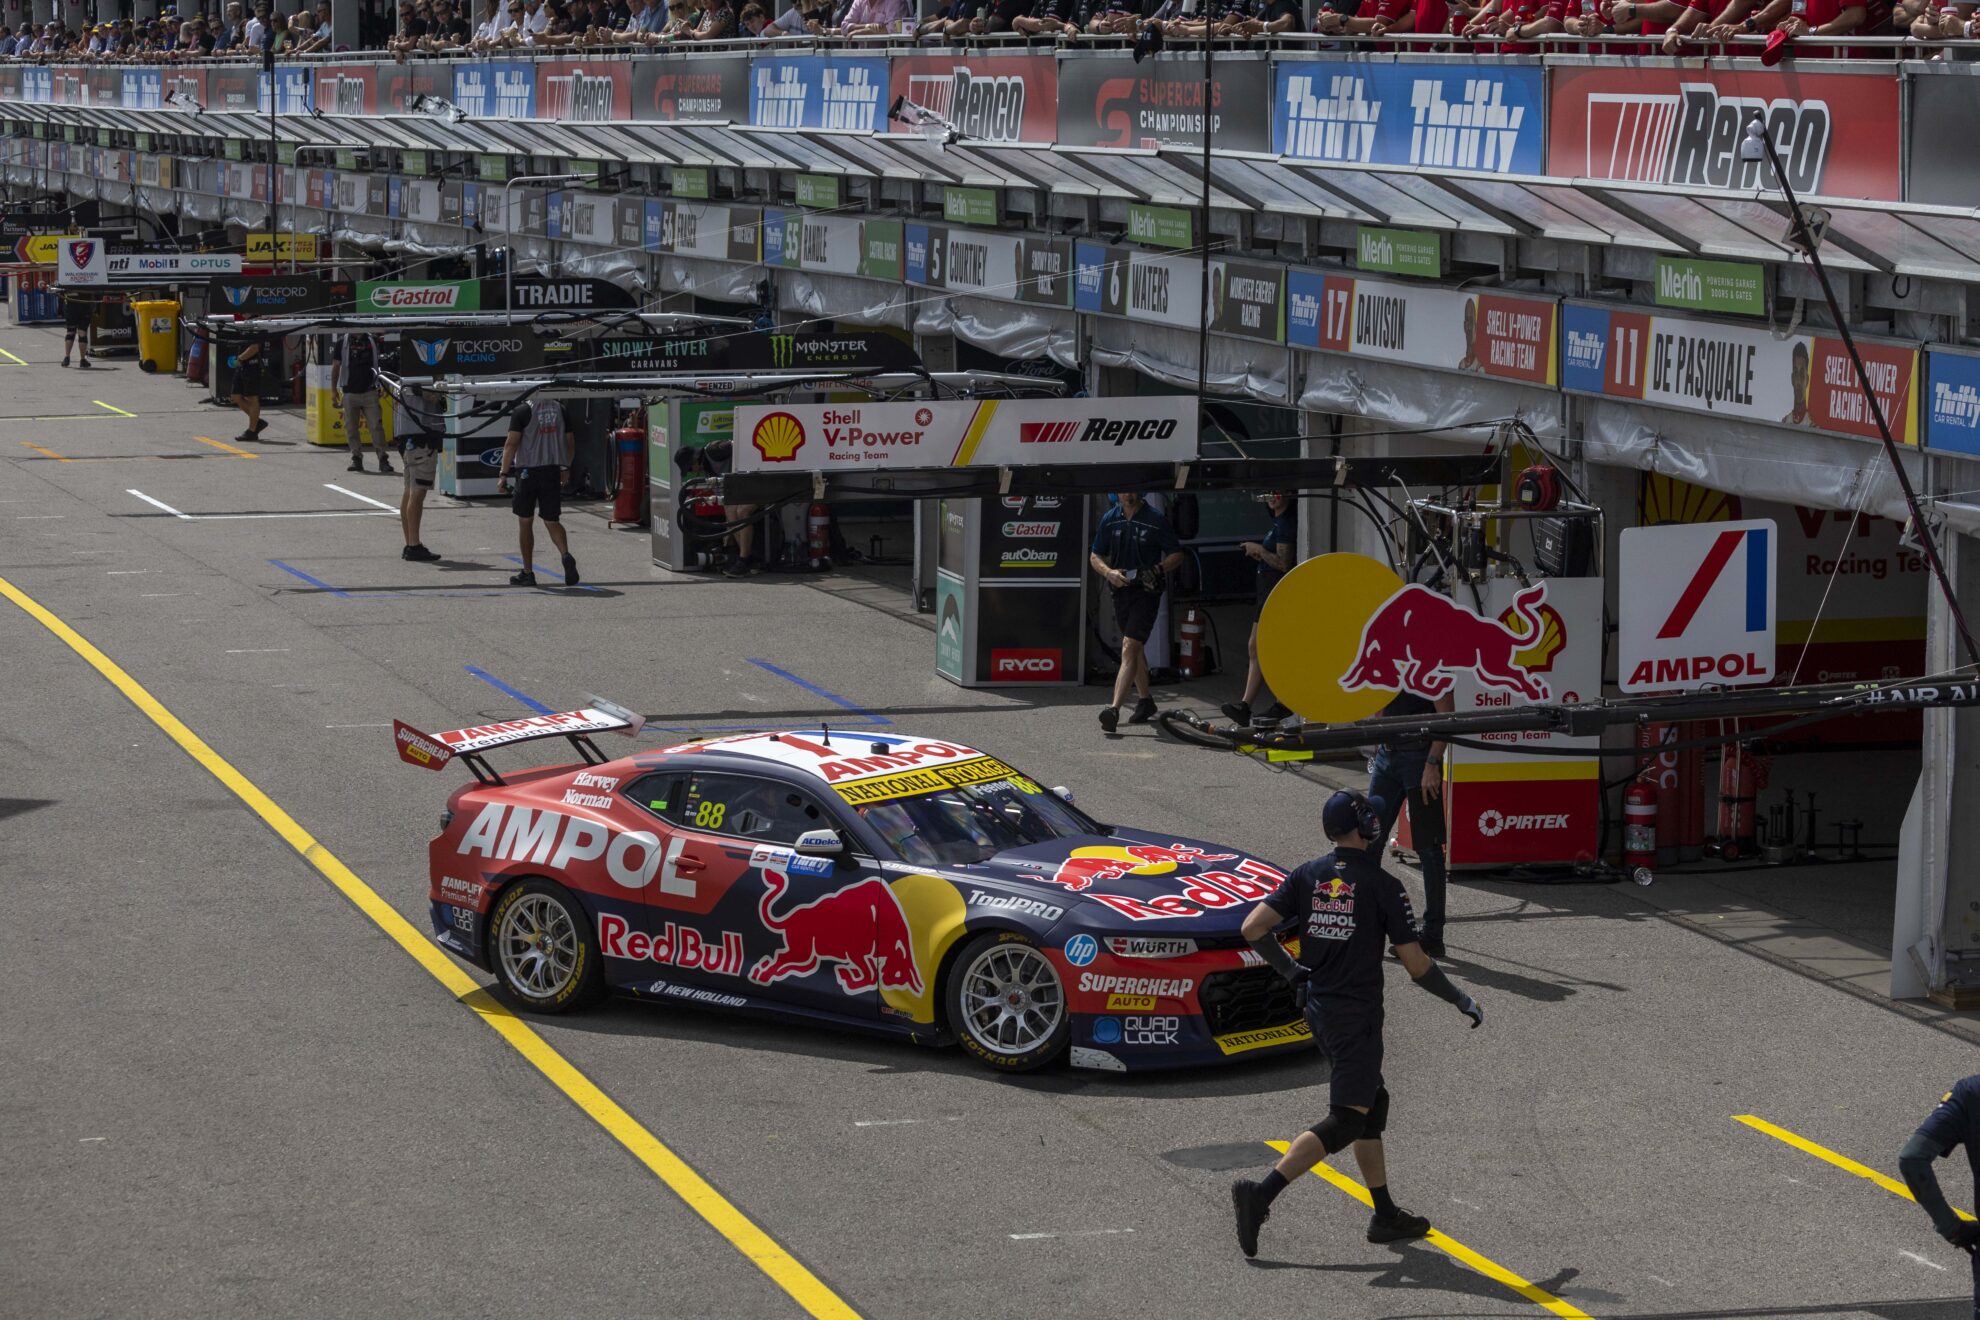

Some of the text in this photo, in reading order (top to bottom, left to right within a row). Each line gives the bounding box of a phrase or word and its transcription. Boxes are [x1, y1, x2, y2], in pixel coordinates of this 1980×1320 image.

[572, 69, 613, 121] Repco
[678, 98, 721, 113] CHAMPIONSHIP
[756, 66, 808, 127] Thrifty
[822, 67, 880, 130] Thrifty
[953, 66, 1025, 141] Repco
[1285, 76, 1382, 163] Thrifty
[1409, 79, 1525, 174] Thrifty
[1667, 83, 1831, 196] Repco
[946, 191, 967, 217] Merlin
[662, 211, 673, 246] 56
[1130, 209, 1156, 238] Merlin
[249, 241, 287, 253] JAX
[785, 222, 799, 260] 55
[803, 224, 828, 263] RANDLE
[1361, 233, 1392, 265] Merlin
[139, 258, 168, 269] Mobil
[190, 258, 231, 269] OPTUS
[931, 238, 941, 280] 5
[949, 241, 988, 287] COURTNEY
[253, 286, 308, 298] TICKFORD
[515, 284, 593, 306] TRADIE
[1110, 260, 1120, 306] 6
[1131, 263, 1170, 315] WATERS
[1229, 276, 1276, 305] MONSTER ENERGY
[1660, 264, 1702, 301] Merlin
[1706, 276, 1756, 289] POWERING GARAGE
[1710, 289, 1728, 299] DOORS
[1735, 291, 1752, 301] GATES
[256, 297, 287, 305] RACING
[393, 286, 453, 306] Castrol
[1240, 303, 1261, 328] RACING
[1291, 293, 1320, 327] Thrifty
[1327, 289, 1348, 341] 17
[1356, 293, 1406, 350] DAVISON
[111, 326, 131, 336] paoli
[1486, 309, 1542, 343] SHELL V-POWER
[453, 339, 523, 353] TICKFORD
[457, 353, 496, 363] RACING
[602, 339, 708, 358] SNOWY RIVER
[796, 339, 868, 353] MONSTER
[1490, 340, 1536, 371] RACING TEAM
[1567, 329, 1605, 370] Thrifty
[1614, 326, 1639, 387] 11
[631, 359, 678, 369] CARAVANS
[1652, 333, 1756, 410] DE PASQUALE
[1824, 354, 1898, 395] SHELL VPOWER
[708, 381, 733, 391] ENZED
[823, 409, 861, 425] Shell
[1829, 389, 1862, 423] RACING
[1080, 417, 1178, 446] Repco
[1934, 413, 1966, 427] CAR RENTAL
[823, 428, 925, 447] V-Power
[829, 451, 889, 462] Racing Team
[1015, 522, 1057, 536] Castrol
[1806, 553, 1888, 580] Racing
[999, 658, 1055, 672] RYCO
[1627, 652, 1767, 686] AMPOL
[1475, 692, 1511, 707] Shell
[451, 719, 609, 752] Premium Fuels
[466, 710, 591, 740] AMPLIFY
[1481, 730, 1551, 743] Racing Team
[397, 727, 450, 762] SUPERCHEAP
[409, 746, 428, 760] AUTO
[818, 741, 980, 782] AMPOL
[572, 772, 620, 792] Harvey
[840, 759, 1009, 802] NATIONAL STORAGE
[561, 788, 613, 809] Norman
[695, 801, 726, 829] 88
[1504, 814, 1571, 829] PIRTEK
[456, 801, 697, 898] AMPOL
[801, 837, 842, 846] ACDelco
[441, 887, 467, 903] Premium
[447, 878, 484, 896] AMPLIFY
[452, 906, 474, 922] QUAD
[492, 886, 527, 935] DUNLOP
[968, 889, 1065, 921] ToolPRO
[1307, 925, 1355, 939] RACING
[1308, 913, 1357, 927] AMPOL
[1068, 935, 1097, 966] hp
[664, 984, 747, 1007] NEW HOLLAND
[1078, 972, 1194, 998] SUPERCHEAP
[1111, 997, 1151, 1007] AUTO
[1124, 1016, 1180, 1032] QUAD
[1124, 1031, 1180, 1045] LOCK
[1223, 1028, 1295, 1047] NATIONAL
